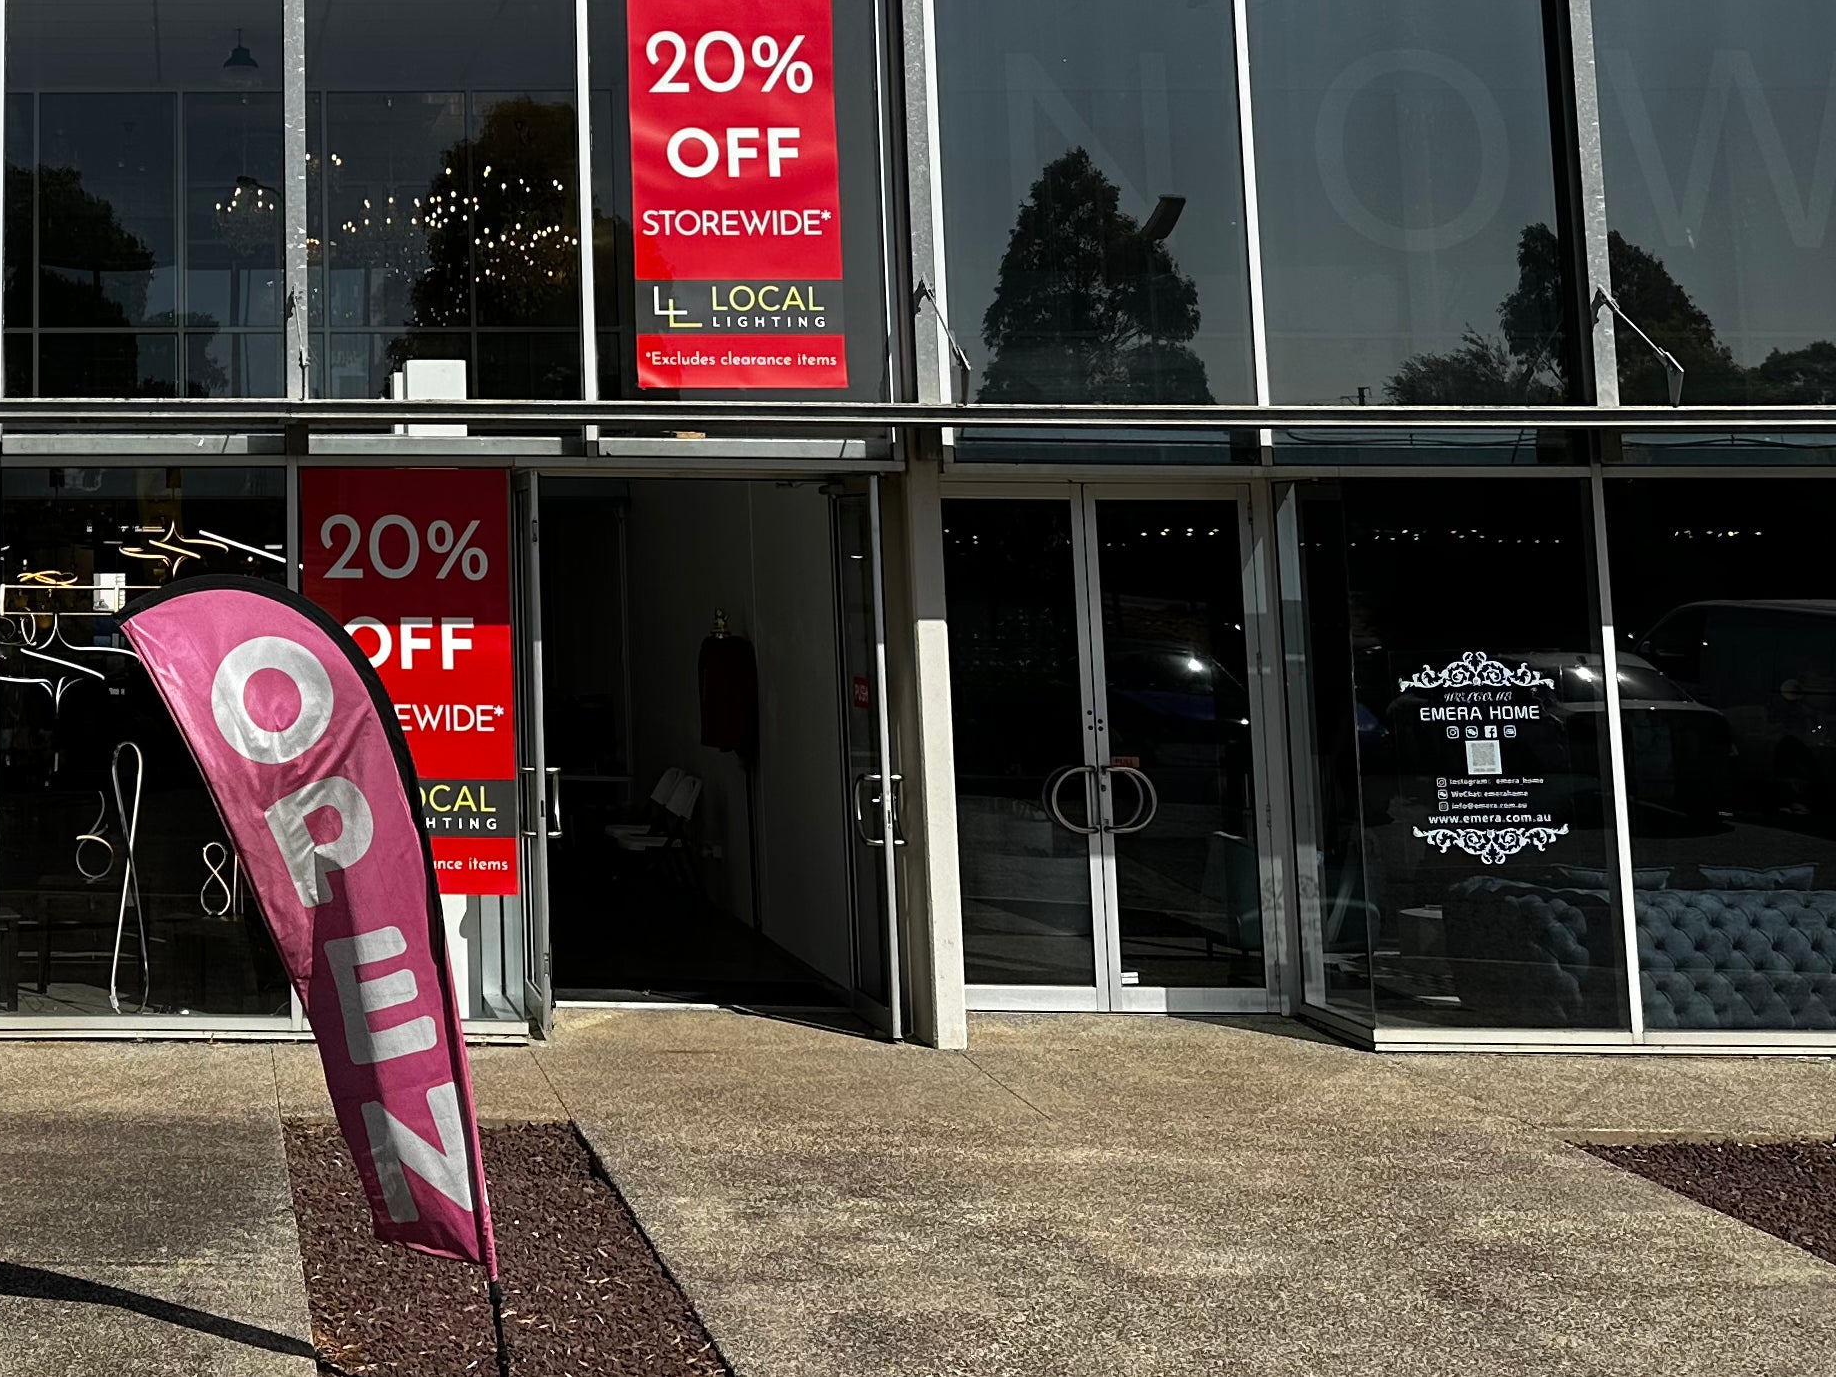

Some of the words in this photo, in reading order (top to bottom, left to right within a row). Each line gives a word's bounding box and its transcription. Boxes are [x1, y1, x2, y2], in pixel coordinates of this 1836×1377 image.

[645, 30, 814, 94] 20%
[666, 127, 800, 178] OFF
[711, 286, 825, 312] LOCAL
[712, 316, 826, 328] LIGHTING
[720, 352, 792, 367] clearance
[797, 353, 838, 366] items
[320, 514, 488, 581] 20%
[344, 616, 474, 670] OFF
[394, 704, 505, 732] EWIDE
[1420, 706, 1483, 721] EMERA
[1489, 705, 1540, 720] HOME
[420, 784, 496, 812] CAL
[426, 817, 497, 830] HTING
[1428, 813, 1552, 824] www.emera.com.au
[468, 854, 508, 871] items
[211, 635, 473, 1223] OPEN
